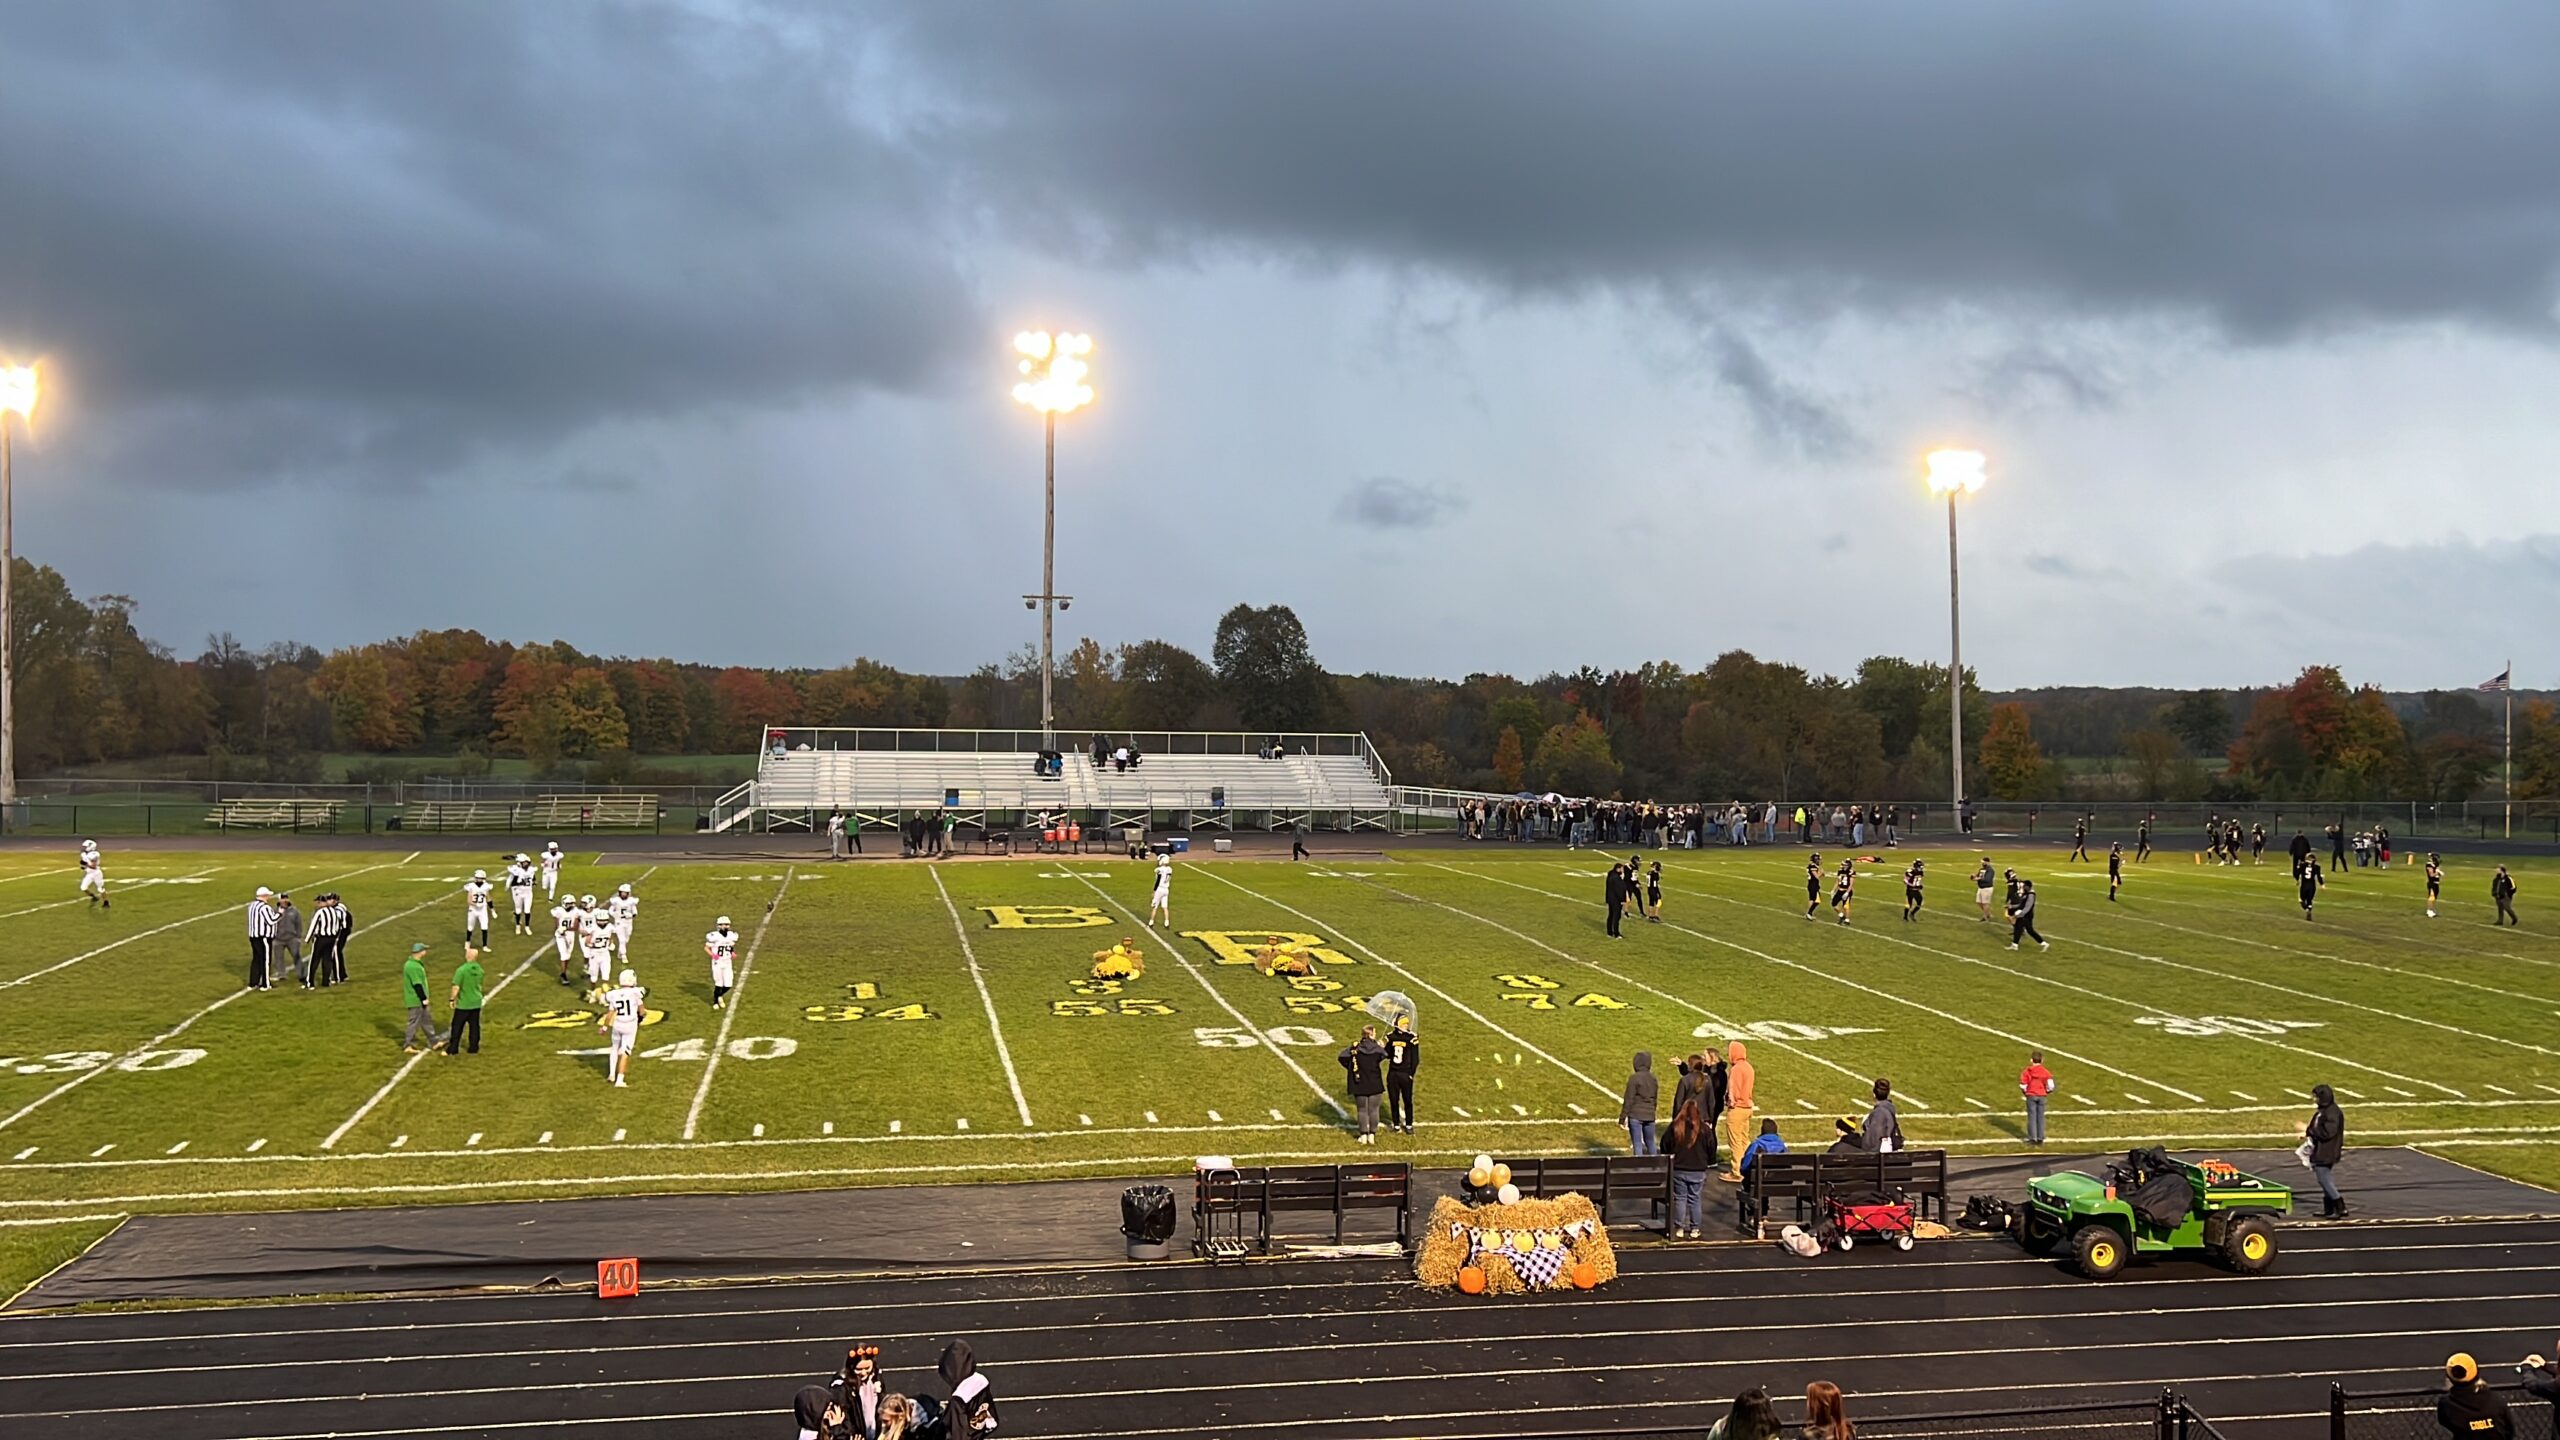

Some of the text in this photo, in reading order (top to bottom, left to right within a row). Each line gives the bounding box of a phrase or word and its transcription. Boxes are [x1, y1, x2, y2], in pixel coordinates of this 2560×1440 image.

[2304, 867, 2313, 879] 5
[978, 906, 1116, 929] B
[1179, 931, 1357, 965] R
[1287, 976, 1344, 992] 5
[1496, 974, 1561, 989] 8
[846, 982, 888, 1000] 1
[615, 999, 631, 1016] 21
[1052, 999, 1176, 1016] 55
[1501, 993, 1631, 1010] 74
[806, 1004, 936, 1021] 34
[1692, 1020, 1829, 1041] 40
[2133, 1015, 2288, 1036] 30
[1193, 1025, 1335, 1048] 50
[638, 1036, 798, 1062] 40
[1393, 1046, 1404, 1064] 9
[16, 1048, 209, 1074] 30
[603, 1263, 635, 1291] 40
